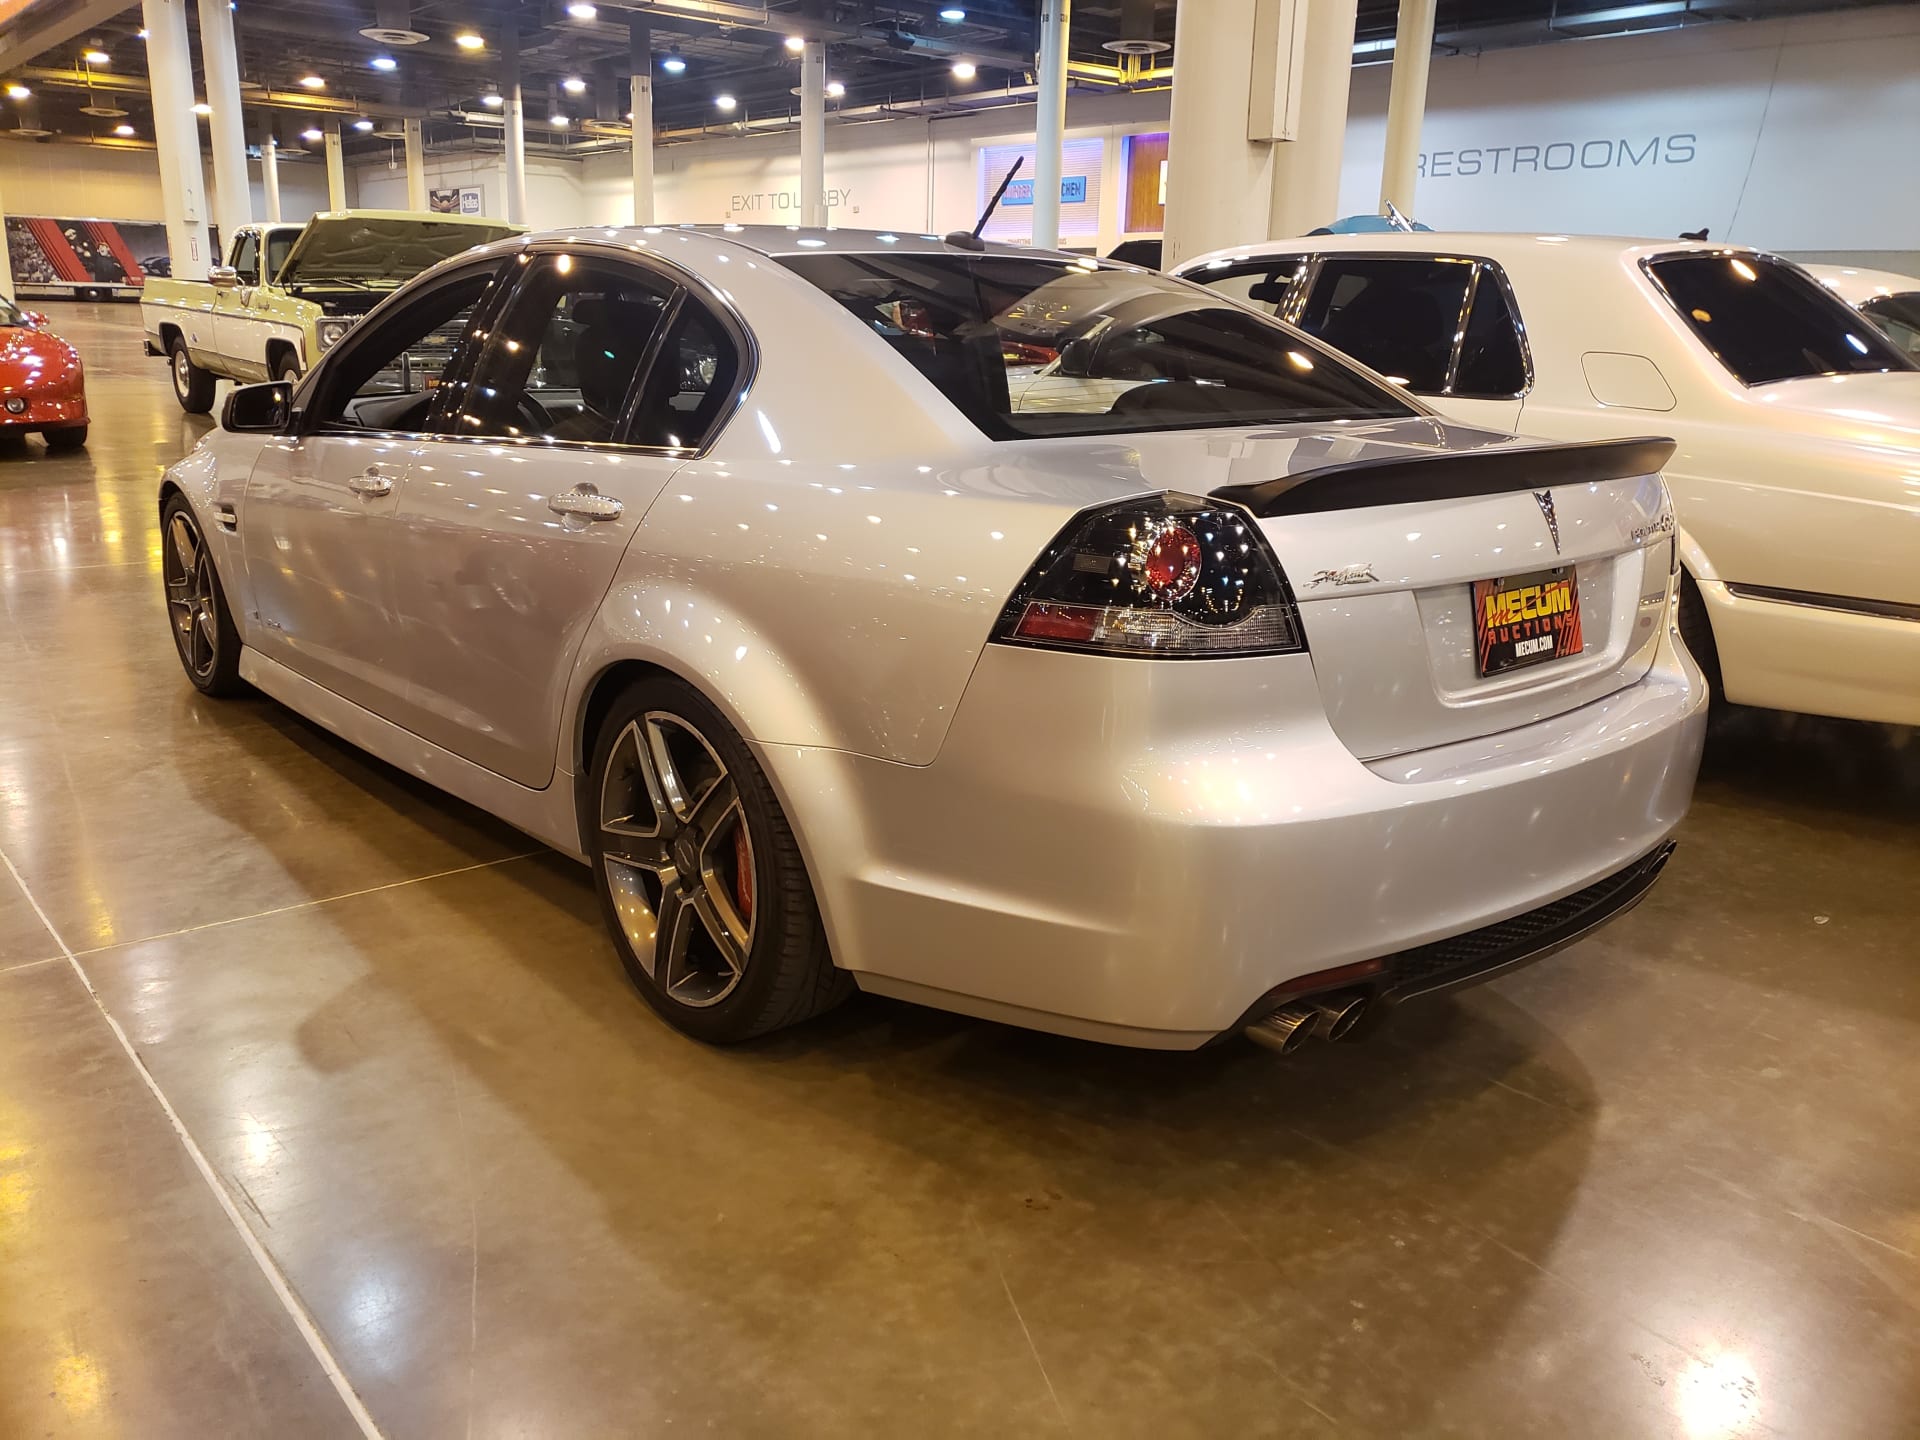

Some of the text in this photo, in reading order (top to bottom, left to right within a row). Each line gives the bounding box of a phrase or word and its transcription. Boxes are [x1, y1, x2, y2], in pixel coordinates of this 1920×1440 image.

[731, 188, 852, 212] EXIT TO LBY
[1060, 182, 1081, 197] CHEN
[1485, 579, 1572, 628] MECUM
[1487, 612, 1573, 645] AUCTIONS
[1515, 635, 1554, 658] MECUM.COM
